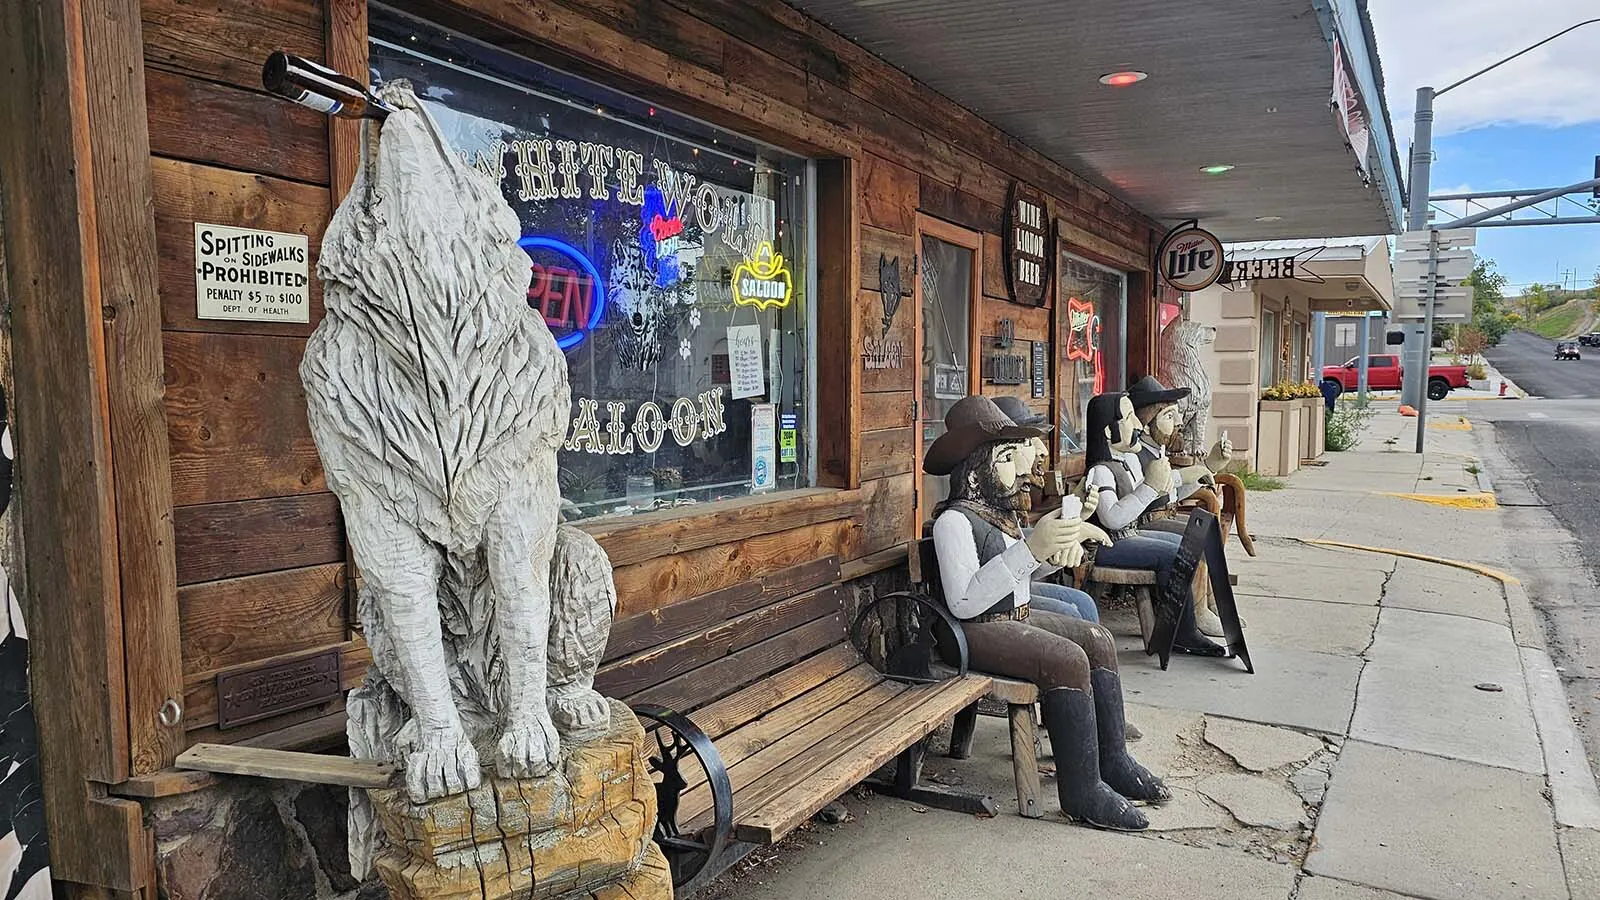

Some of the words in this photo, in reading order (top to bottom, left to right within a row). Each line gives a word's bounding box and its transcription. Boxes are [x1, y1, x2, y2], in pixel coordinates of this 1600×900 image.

[1018, 200, 1041, 230] WINE
[201, 230, 274, 256] SPITTING
[1016, 228, 1044, 258] LIQUOR
[1176, 238, 1205, 255] Miller
[242, 246, 304, 268] SIDEWALKS
[1168, 249, 1216, 279] Lite
[202, 261, 304, 288] PROHIBITED
[1018, 258, 1040, 286] BEER
[206, 288, 243, 301] PENALTY
[248, 291, 262, 304] $5
[265, 294, 275, 304] TO
[279, 293, 302, 305] $100
[526, 263, 593, 329] PEN
[741, 278, 786, 300] SALOON
[223, 305, 243, 313] DEPT.
[248, 306, 258, 314] OF
[263, 307, 289, 315] HEALTH
[564, 386, 727, 454] ALOON
